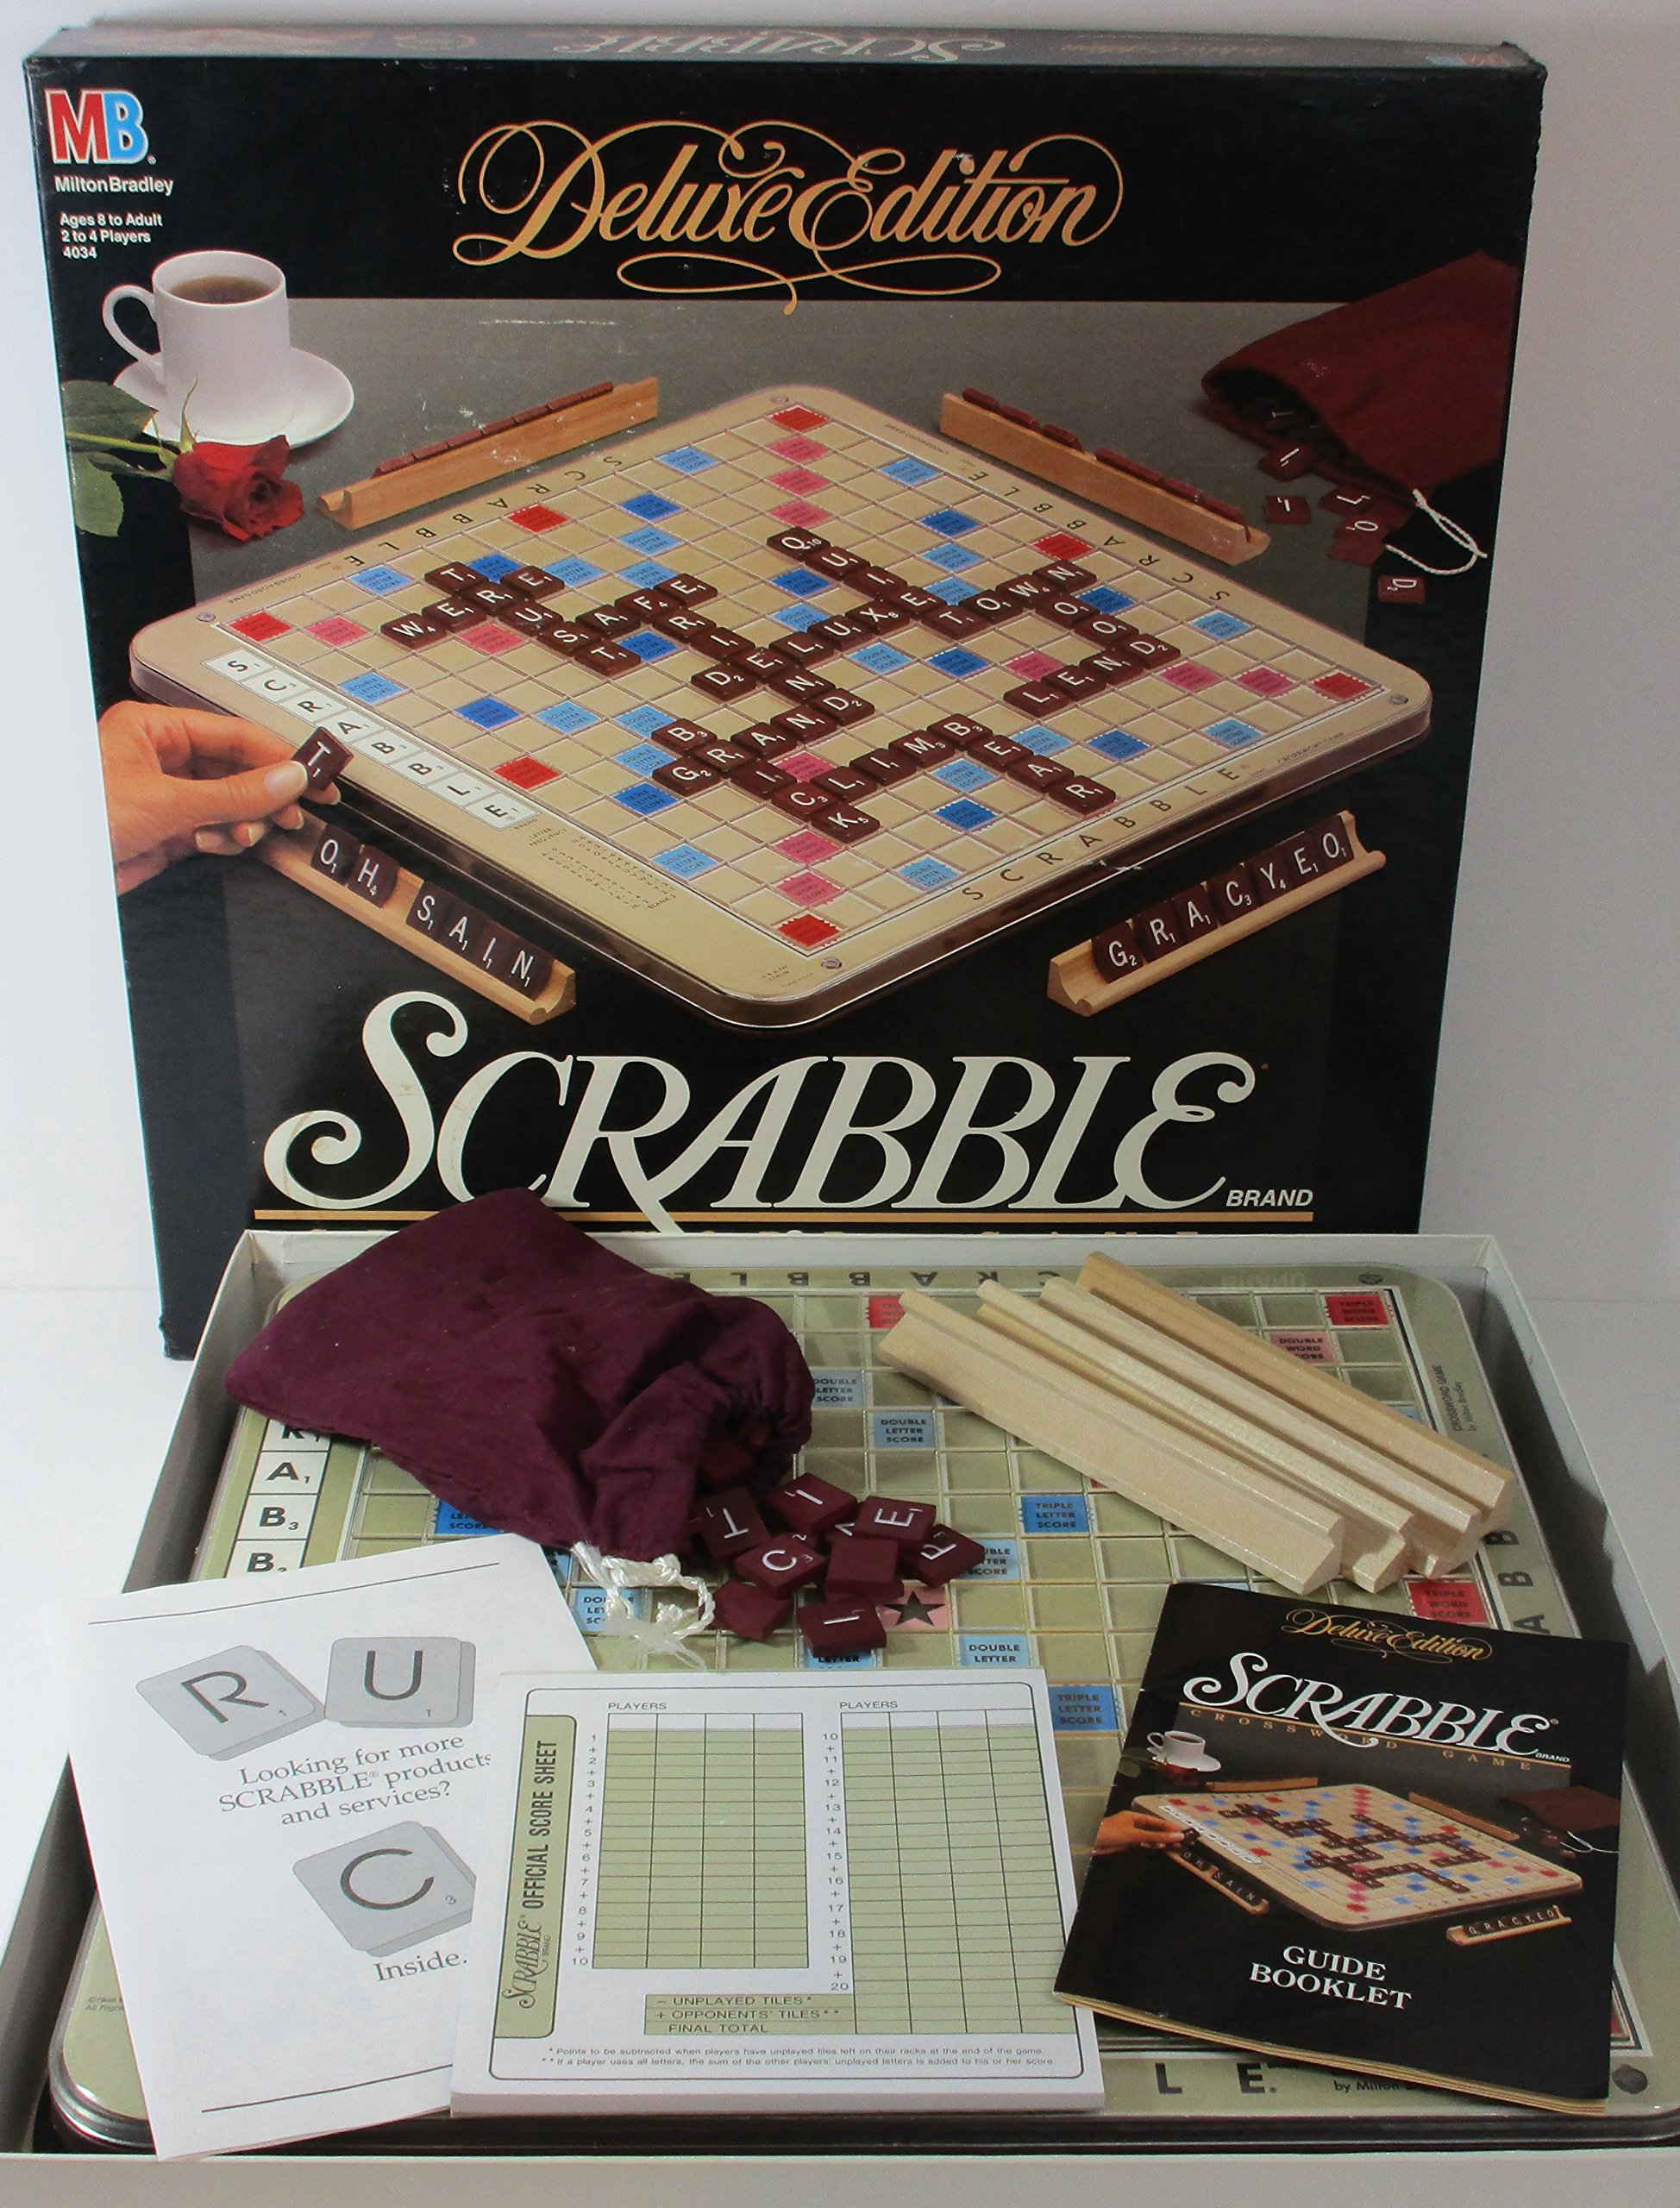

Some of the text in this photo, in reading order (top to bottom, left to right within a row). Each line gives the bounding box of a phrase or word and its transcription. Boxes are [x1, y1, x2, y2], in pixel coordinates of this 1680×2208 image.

[44, 88, 149, 164] MB
[453, 120, 1123, 267] Deluxe Edition
[60, 212, 163, 229] Ages 8 to Adult
[61, 229, 152, 246] 2 to 4 Players
[63, 247, 97, 259] 4034
[263, 990, 1313, 1233] SCRABBLE BRAND
[1282, 1609, 1493, 1662] Deluxe Edition
[969, 1643, 1020, 1652] DOUBLE
[818, 1654, 860, 1663] LETTER
[607, 1702, 667, 1710] PLAYERS
[839, 1700, 899, 1709] PLAYERS
[1183, 1653, 1570, 1764] SCRABBLE BRAND
[823, 1733, 838, 1741] 10
[238, 1736, 464, 1785] Looking for more
[281, 1780, 451, 1825] and services?
[522, 1740, 558, 1910] OFFICIAL SCORE SHEET
[830, 1929, 846, 1938] 18
[374, 1951, 467, 1983] Inside.
[831, 1955, 847, 1964] 19
[1282, 1945, 1388, 1982] GUIDE
[1249, 1963, 1413, 2010] BOOKLET
[673, 1996, 755, 2006] UNPLAYED
[669, 2023, 769, 2034] FINAL TOTAL
[705, 2048, 740, 2056] players
[770, 2048, 814, 2056] unplayed
[1016, 2048, 1044, 2056] game.
[576, 2058, 606, 2067] player
[651, 2058, 685, 2067] letters,
[793, 2058, 831, 2067] players'
[835, 2058, 879, 2067] unplayed
[1333, 2079, 1351, 2093] by
